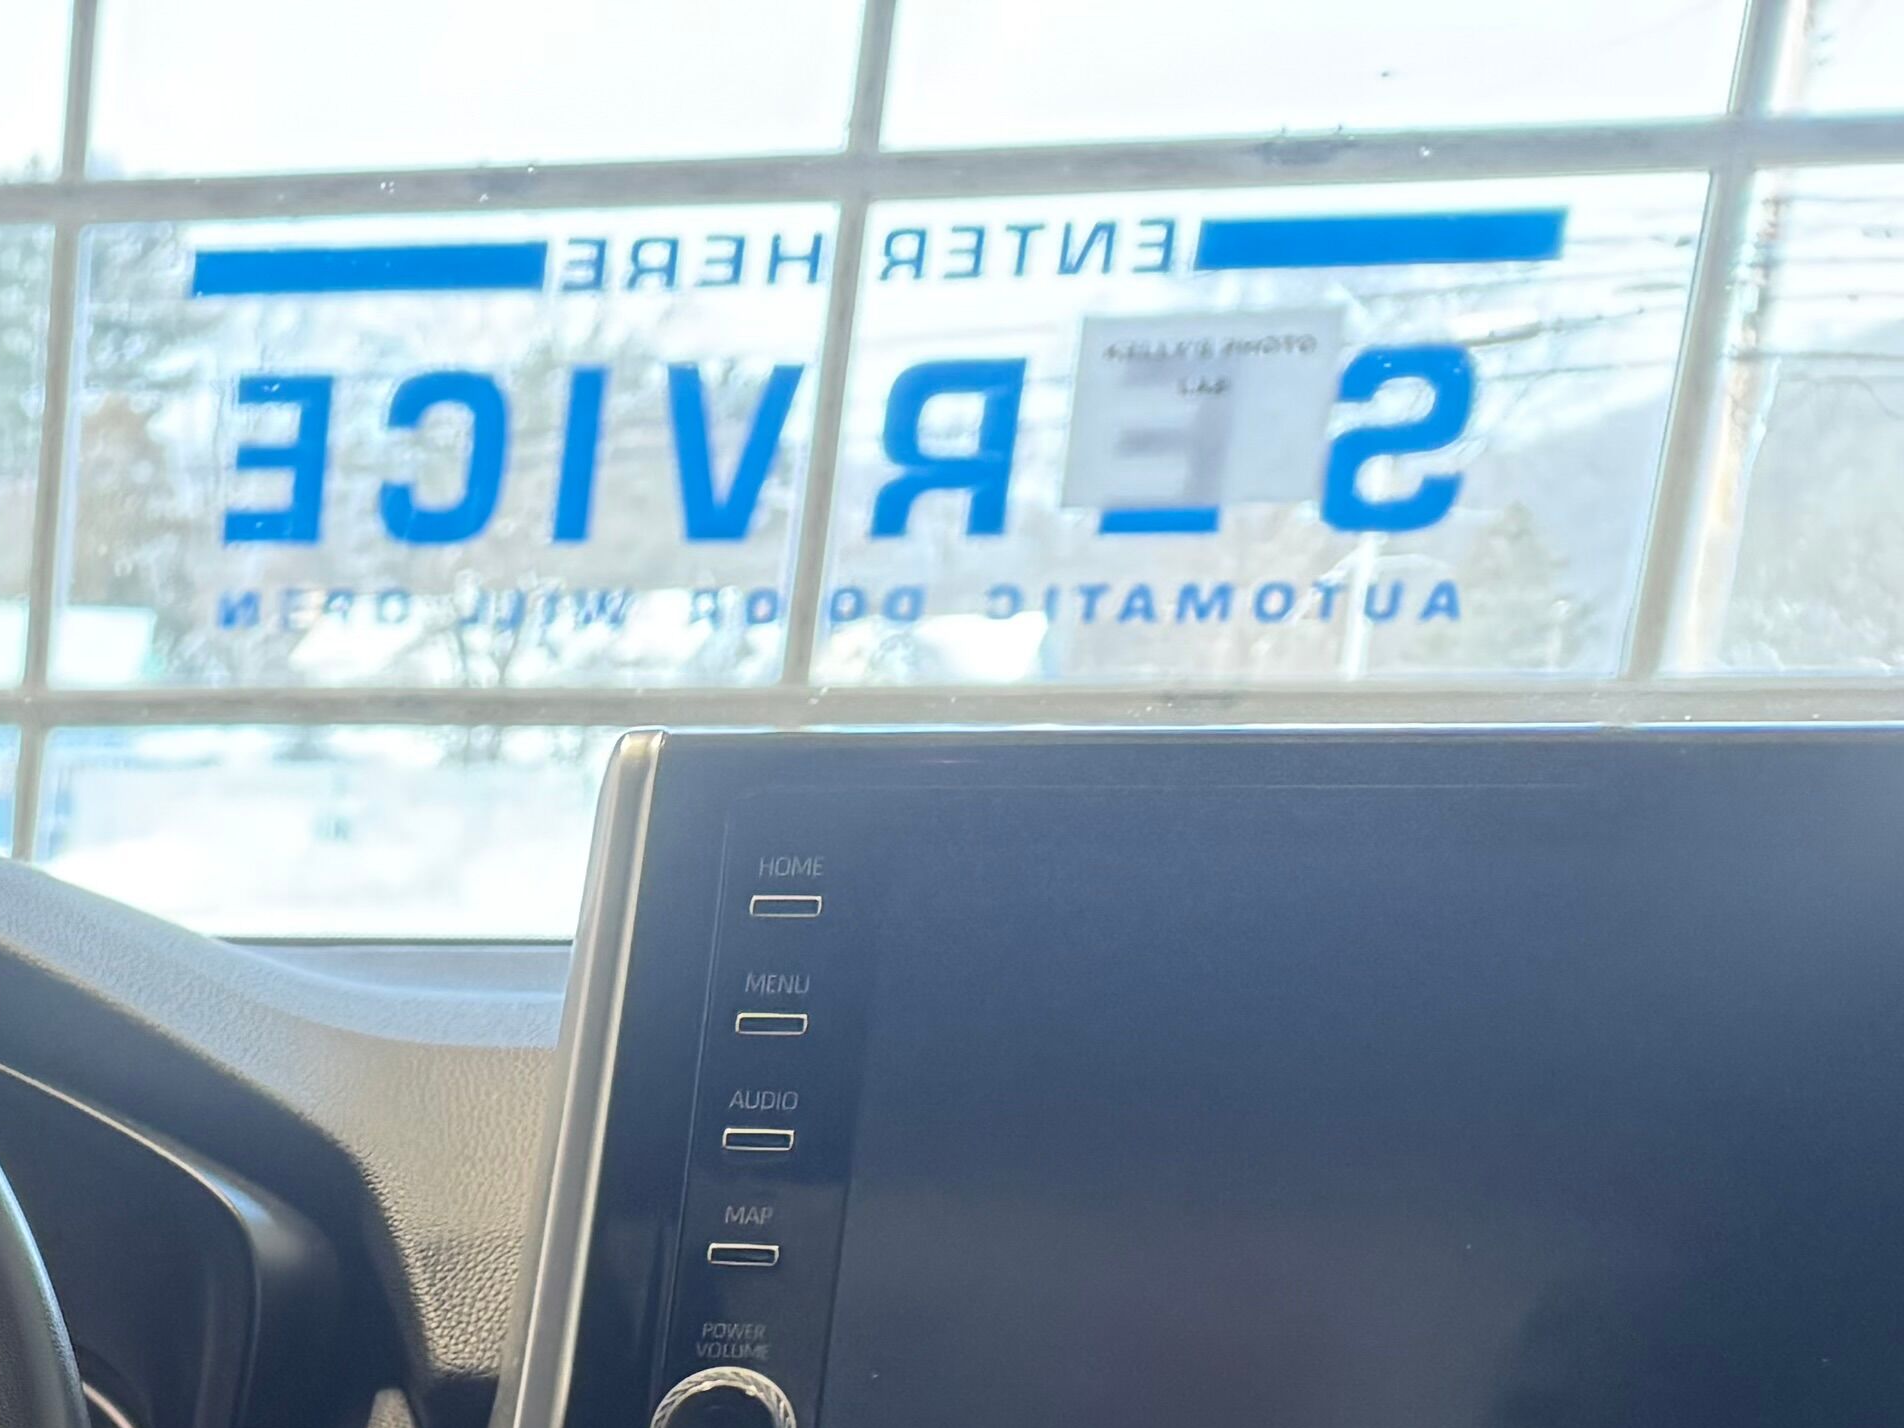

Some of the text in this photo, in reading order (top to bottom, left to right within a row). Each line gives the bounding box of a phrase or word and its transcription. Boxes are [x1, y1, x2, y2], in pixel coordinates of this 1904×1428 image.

[758, 856, 824, 877] HOME
[745, 973, 810, 995] MENU
[728, 1089, 799, 1111] AUDIO
[724, 1206, 774, 1226] MAP
[702, 1323, 765, 1340] POWER
[696, 1342, 771, 1360] VOLUME
